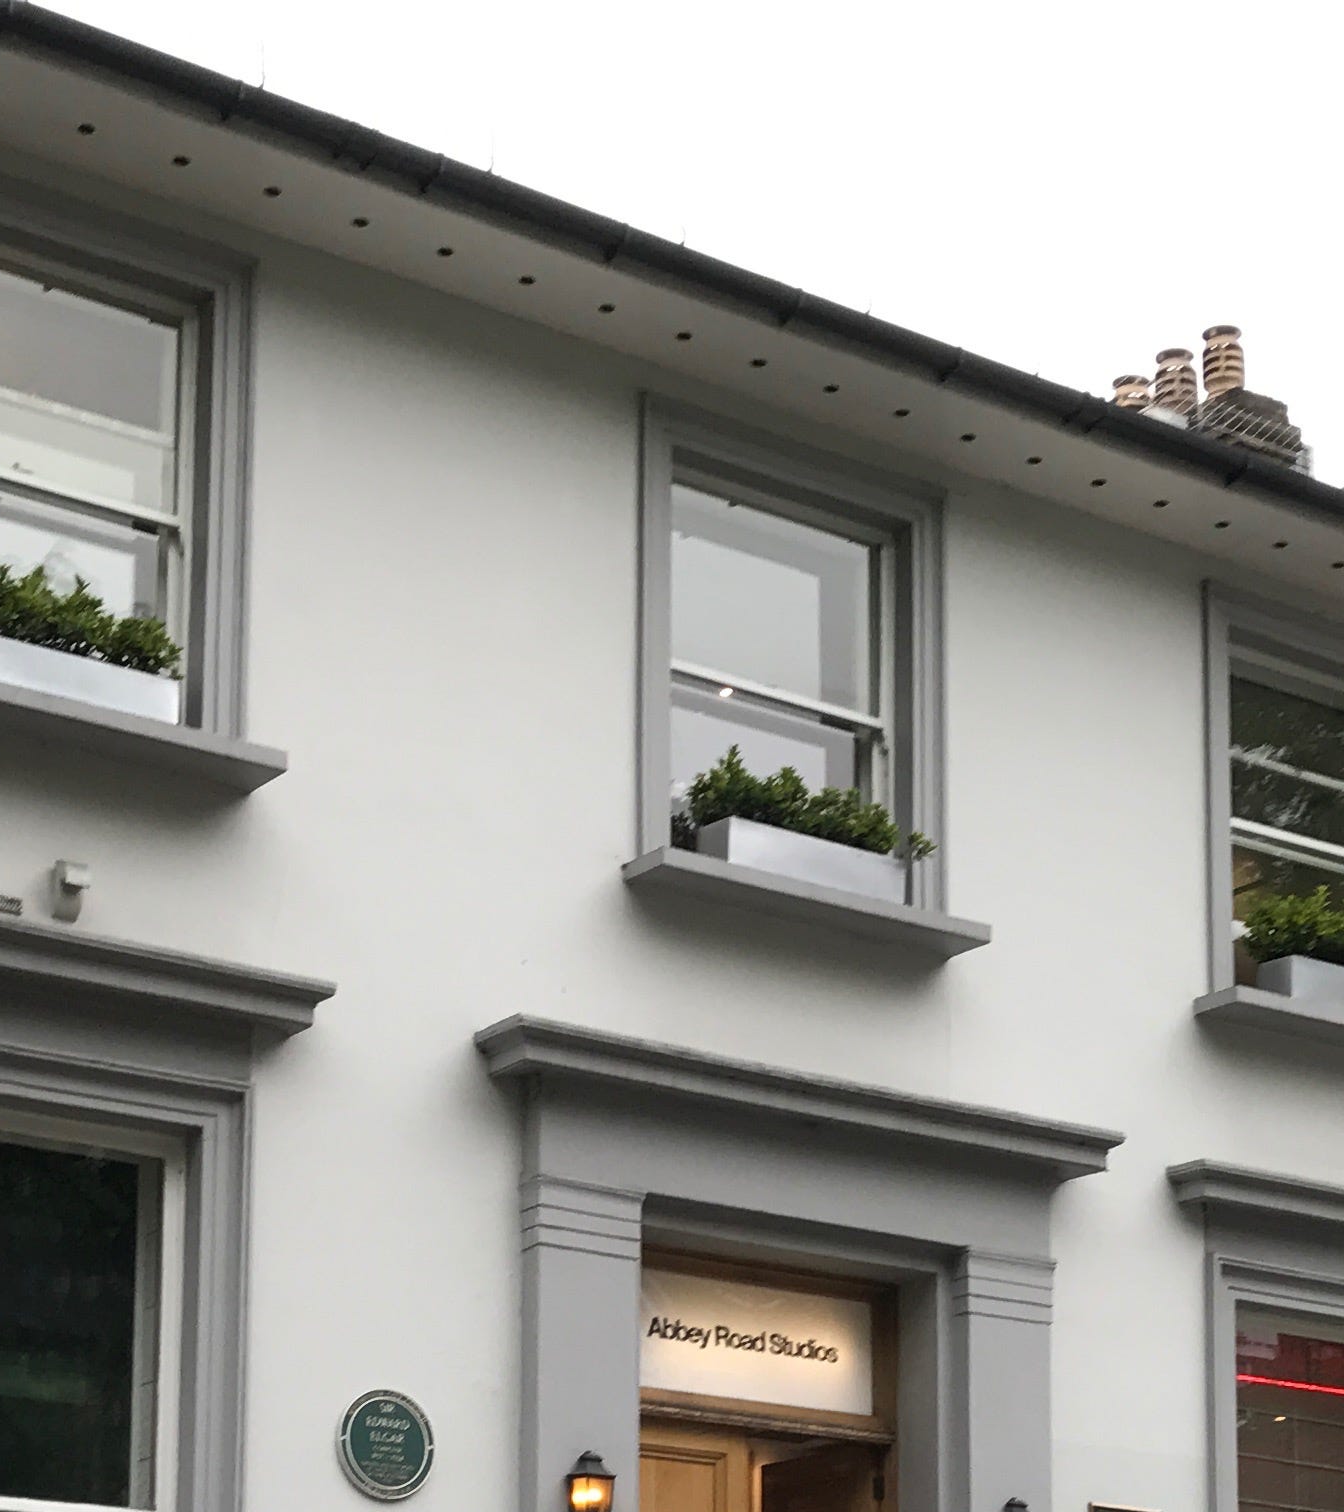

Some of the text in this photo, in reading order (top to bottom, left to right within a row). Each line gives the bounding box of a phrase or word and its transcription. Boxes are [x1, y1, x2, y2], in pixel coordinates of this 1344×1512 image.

[646, 1316, 839, 1363] Abbey Road Studios
